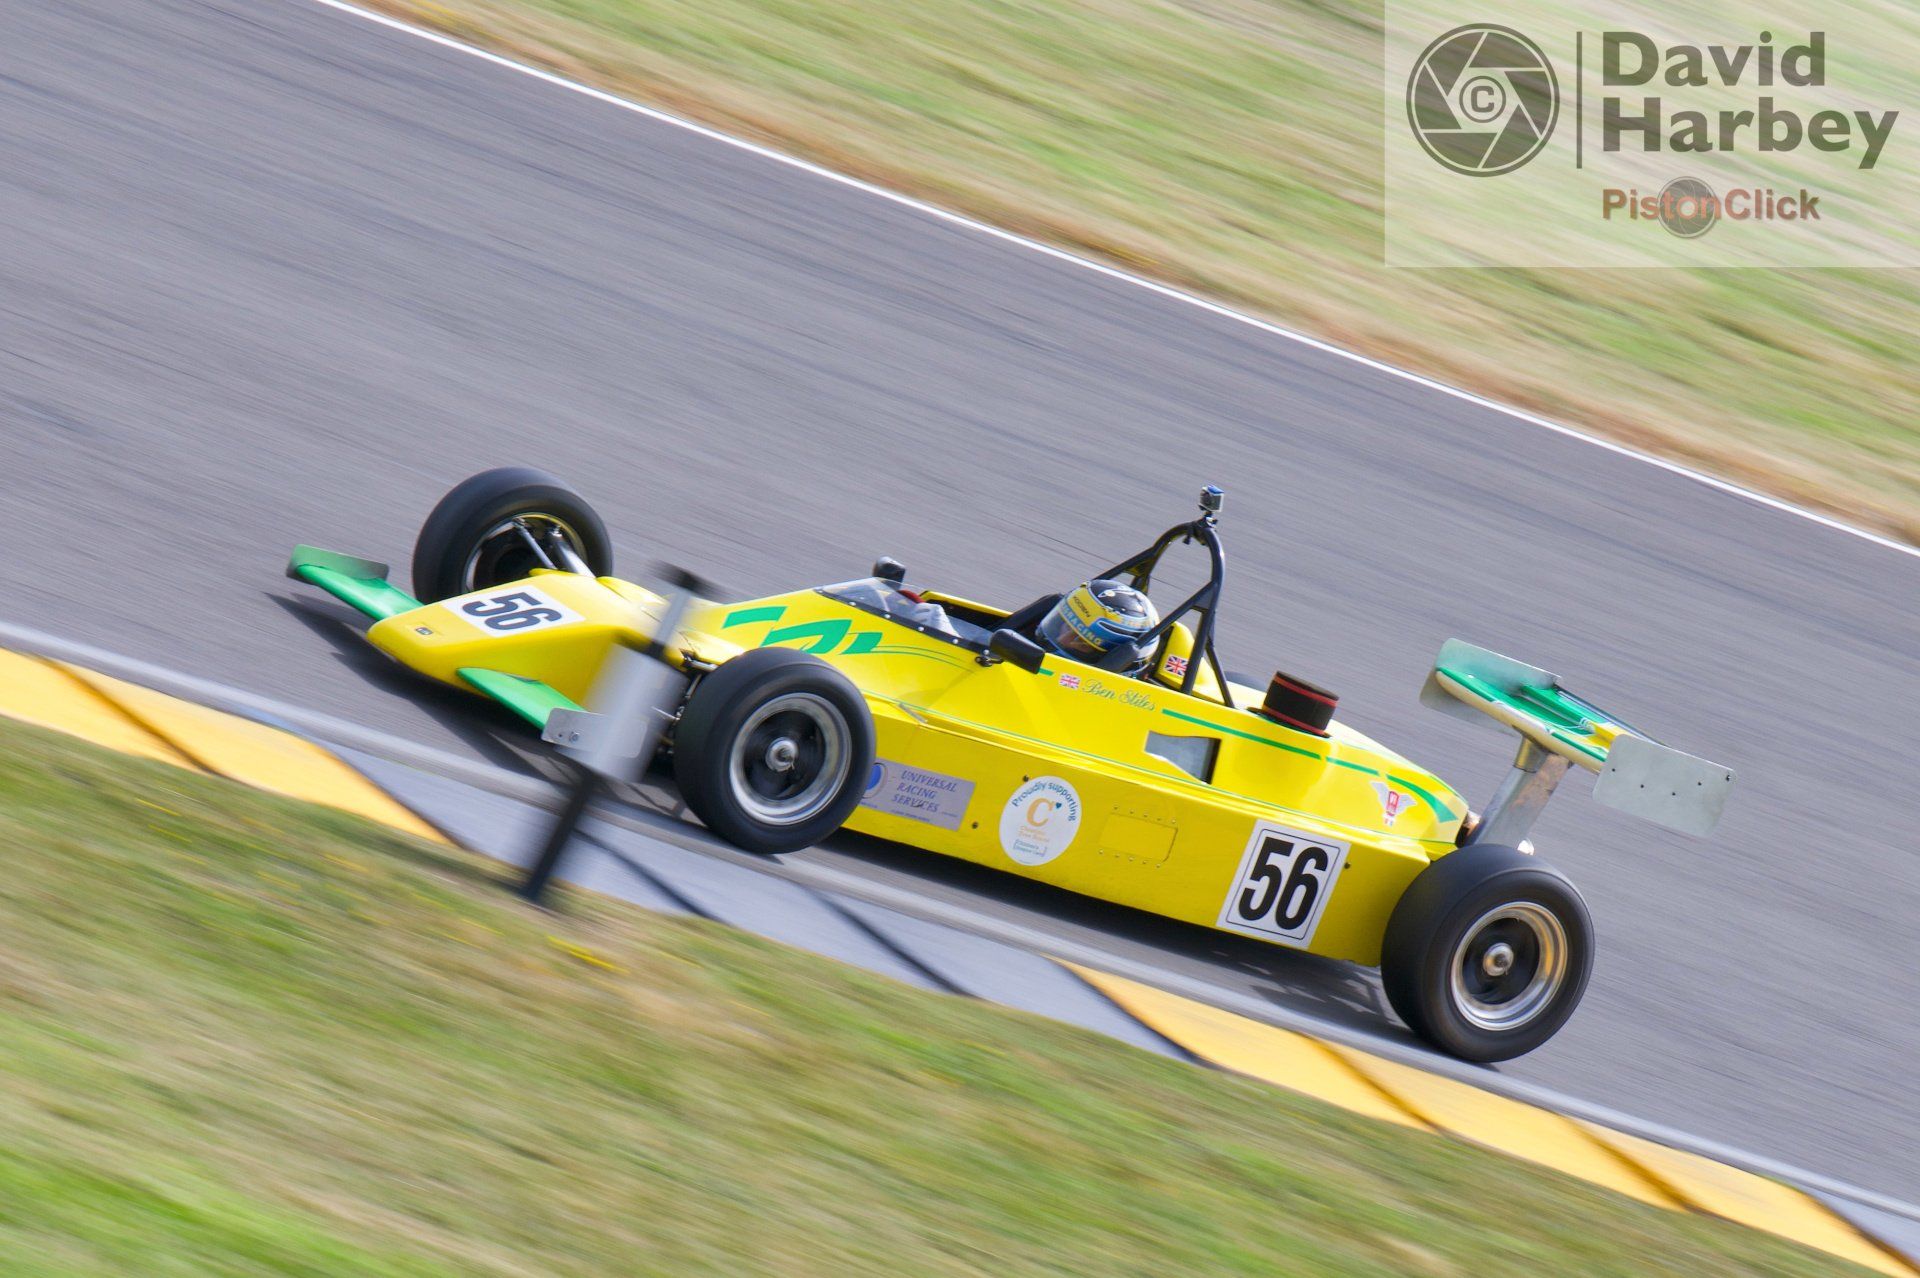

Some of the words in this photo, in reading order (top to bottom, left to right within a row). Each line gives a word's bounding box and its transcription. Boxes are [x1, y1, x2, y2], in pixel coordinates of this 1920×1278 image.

[462, 592, 562, 631] 56
[1082, 677, 1115, 700] Ben
[1119, 689, 1155, 711] Stiles
[897, 782, 936, 799] RACING
[901, 770, 958, 792] UNIVERSAL
[891, 793, 941, 813] SERVICES
[1012, 781, 1047, 807] Proudly
[1048, 782, 1078, 821] supporting
[1238, 836, 1329, 930] 56
